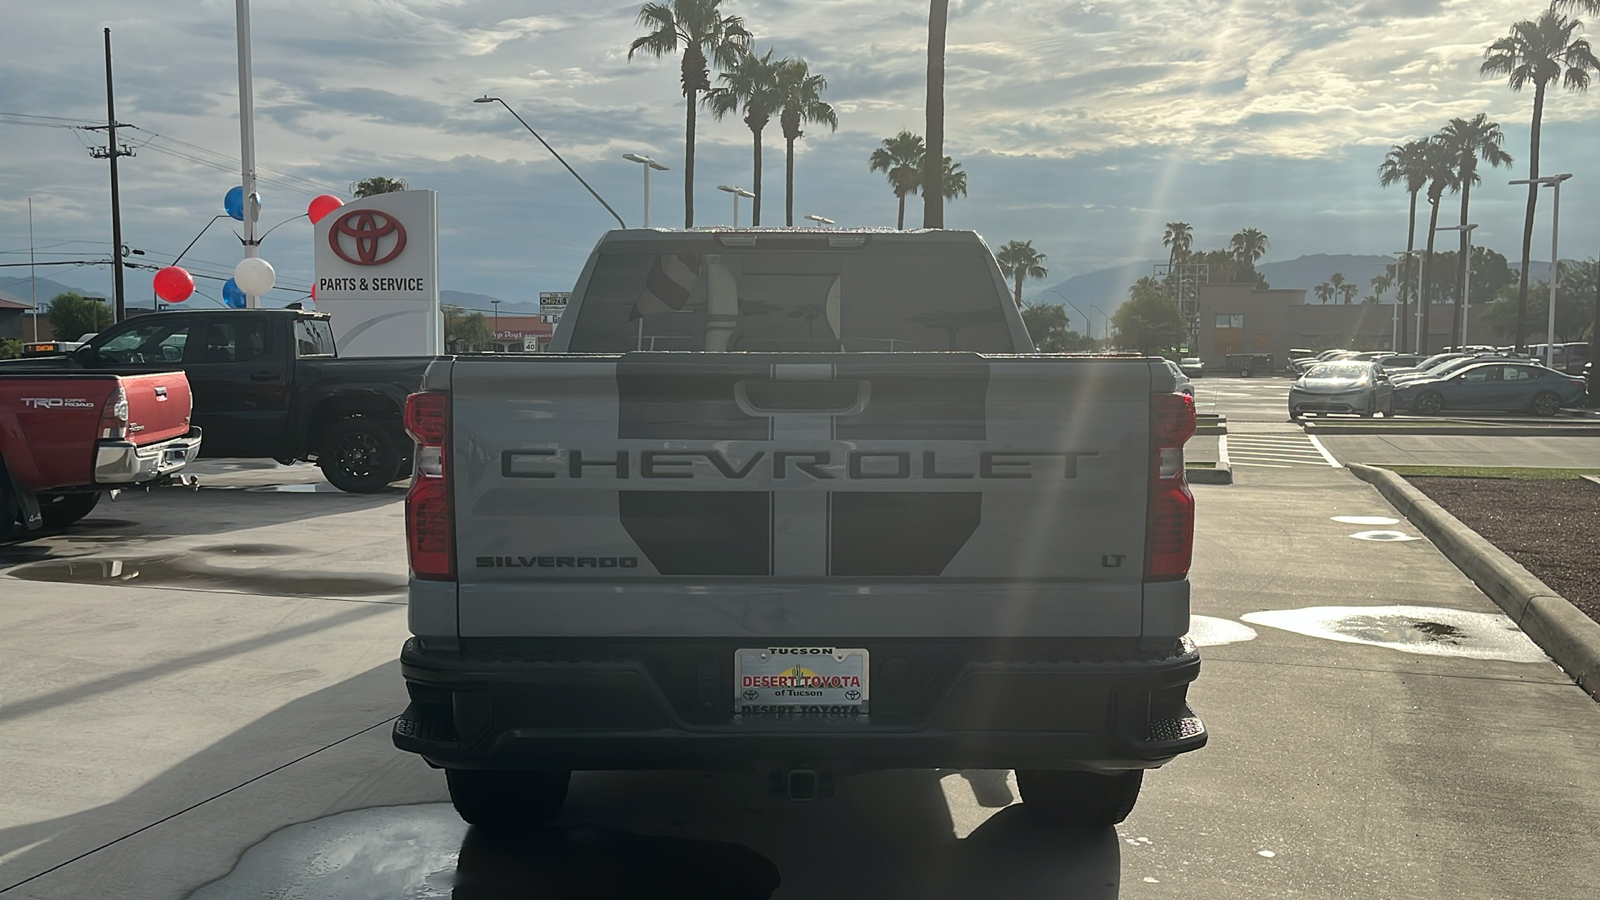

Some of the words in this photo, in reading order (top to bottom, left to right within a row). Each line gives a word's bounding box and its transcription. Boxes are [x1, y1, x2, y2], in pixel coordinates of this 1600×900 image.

[320, 278, 356, 291] PARTS
[359, 278, 369, 291] &
[372, 278, 424, 291] SERVICE
[20, 398, 64, 409] TRD
[500, 451, 1099, 479] CHEVROLET
[476, 556, 638, 568] SILVERADO
[1101, 554, 1127, 568] LT
[742, 676, 797, 687] DESERT
[800, 676, 861, 687] TOYOTA
[741, 705, 795, 713] DESERT
[801, 705, 860, 713] TOYOTA
